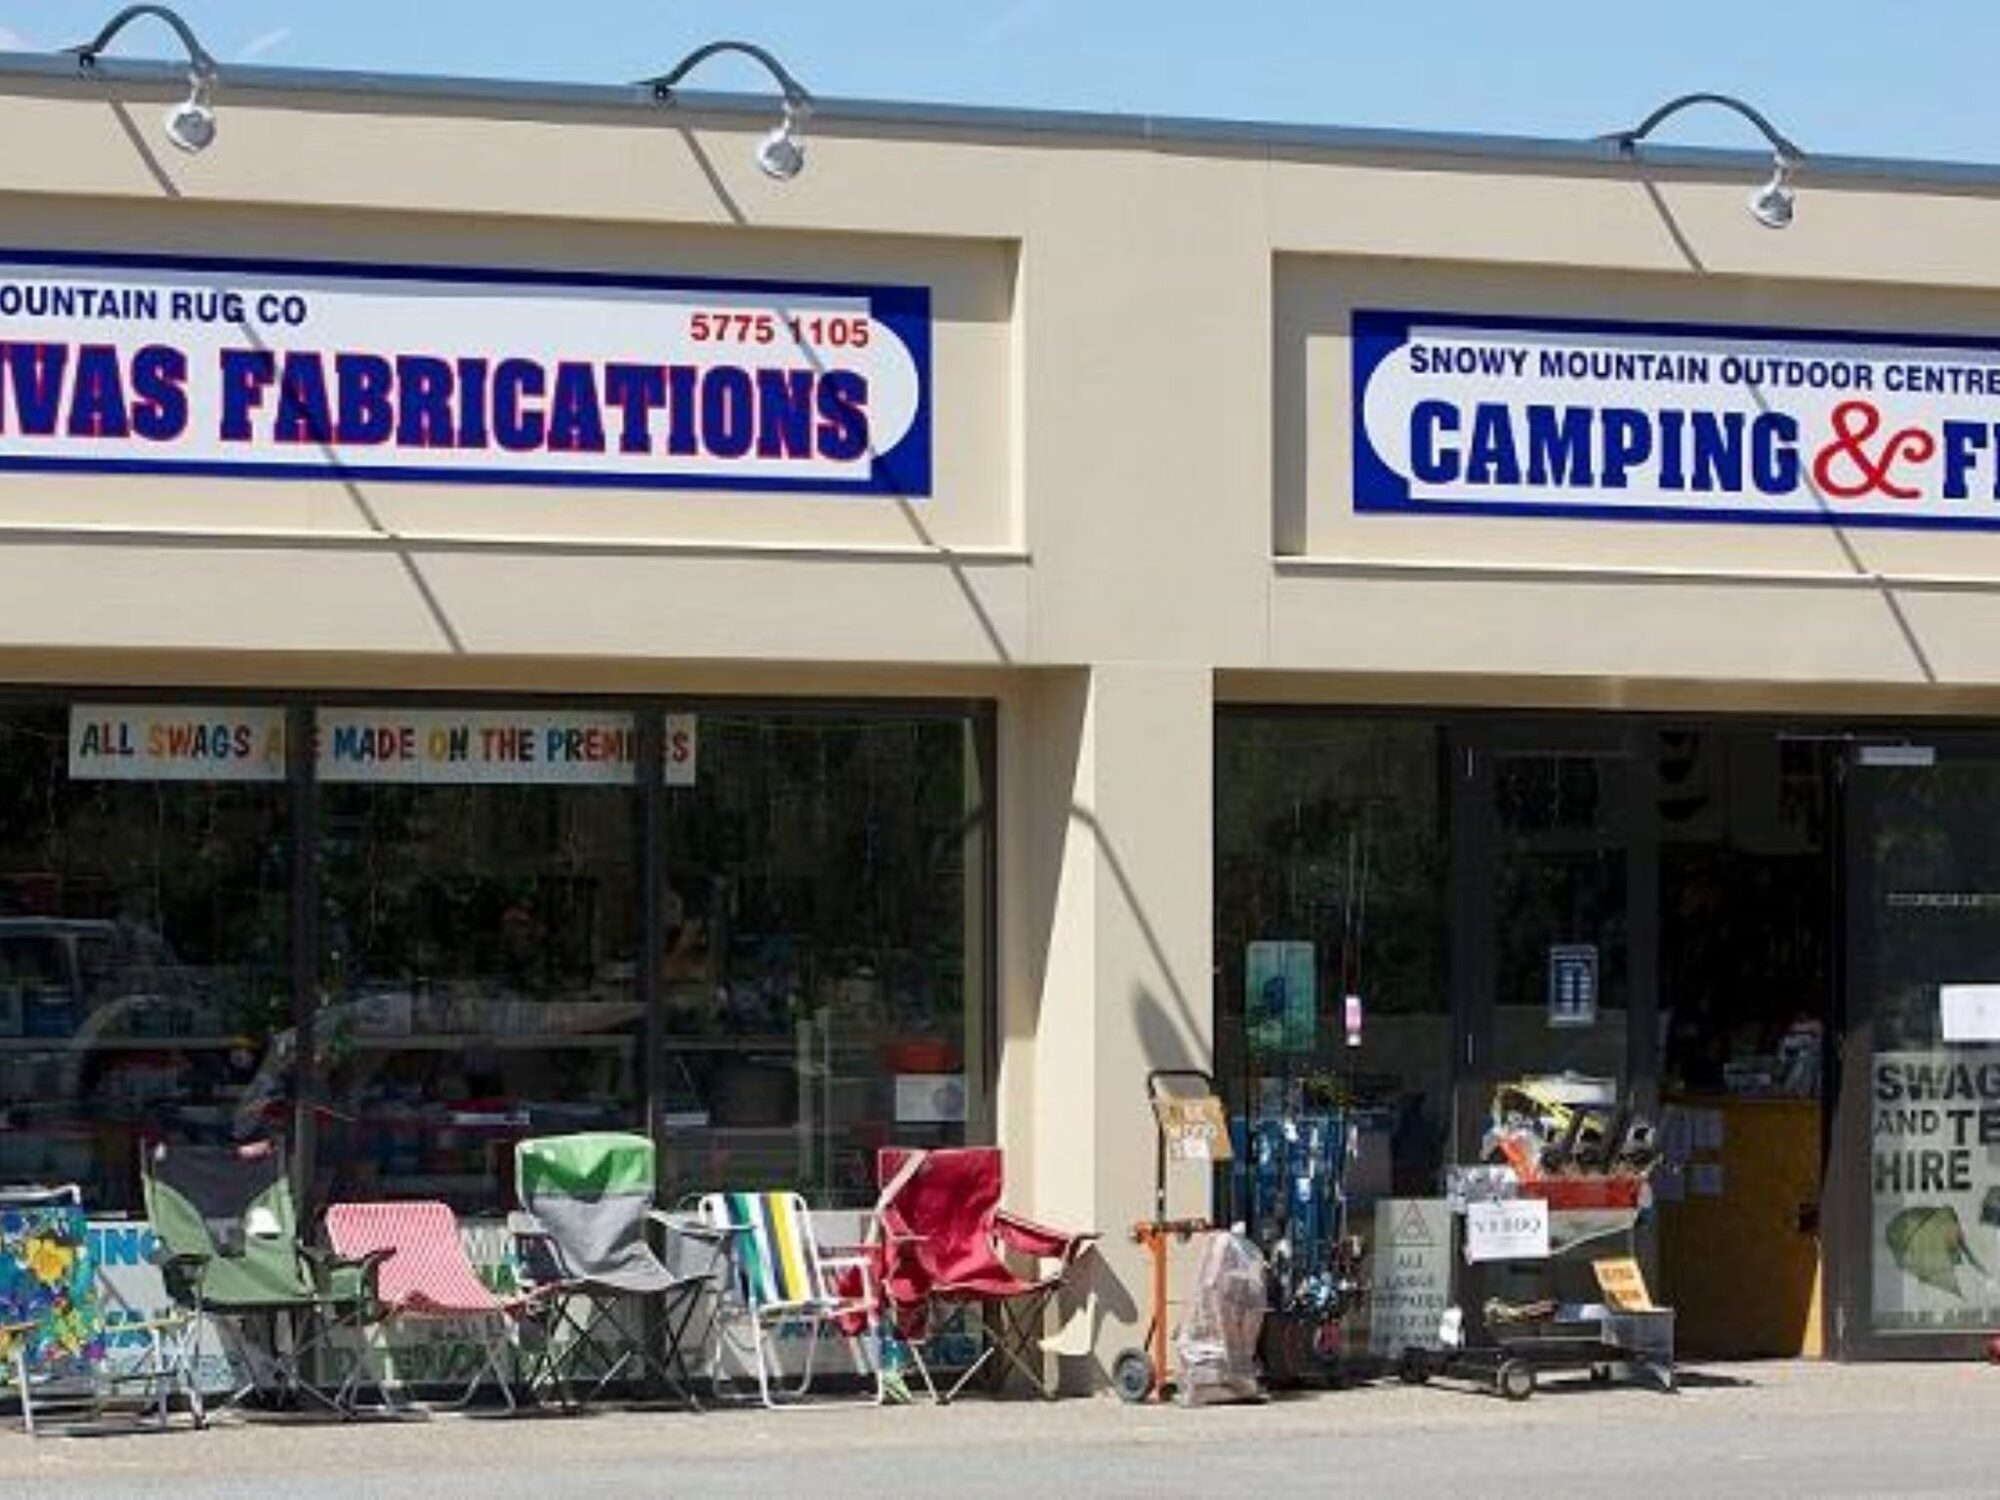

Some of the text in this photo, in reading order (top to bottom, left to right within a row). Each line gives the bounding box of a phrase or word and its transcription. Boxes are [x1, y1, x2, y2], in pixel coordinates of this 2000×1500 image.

[171, 291, 245, 323] RUG
[257, 294, 308, 325] CO
[691, 313, 870, 349] 5775 1105
[1409, 344, 2000, 396] SNOWY MOUNTAIN OUTDOOR CENTRE
[0, 340, 870, 463] VAS FABRICATIONS
[1409, 400, 2000, 500] CAMPING & F
[80, 721, 689, 763] ALL SWAGS AE MADE ON THE PREMIS
[1874, 1109, 1941, 1136] AND
[1874, 1149, 1972, 1193] HIRE
